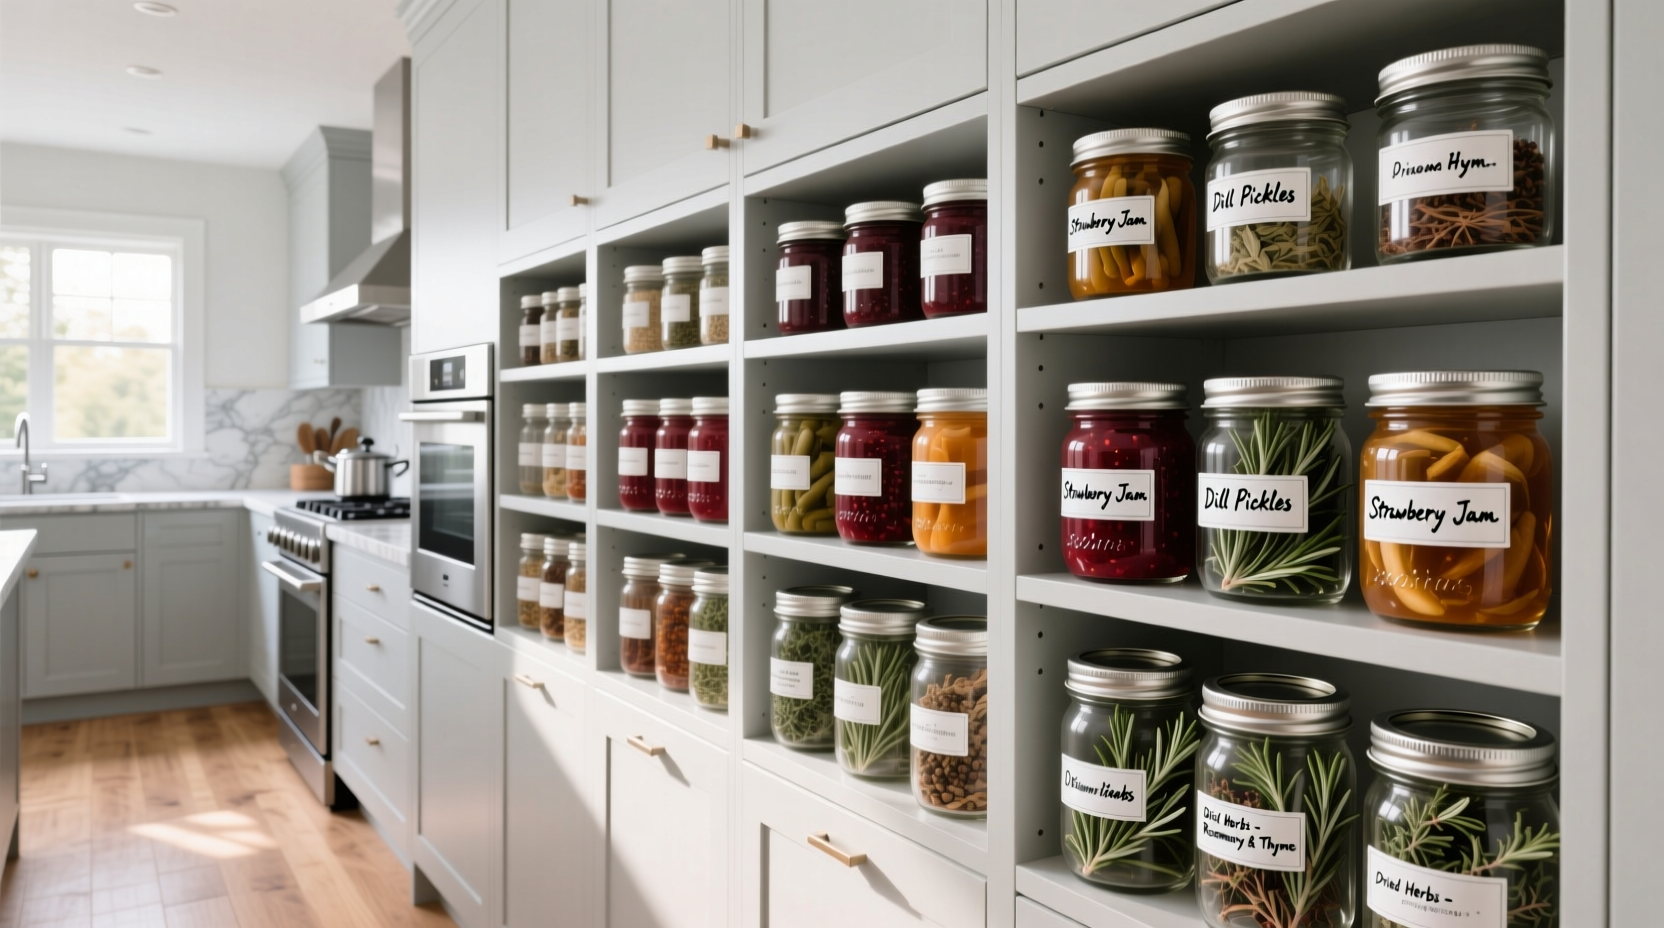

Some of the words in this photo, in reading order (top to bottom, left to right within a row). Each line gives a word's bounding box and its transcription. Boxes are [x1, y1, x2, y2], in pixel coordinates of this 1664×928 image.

[1213, 189, 1234, 212] Dill
[1241, 181, 1295, 207] Pickles
[1118, 209, 1147, 228] Jam
[1116, 483, 1147, 502] Jam
[1205, 488, 1229, 509] Dill
[1235, 488, 1292, 512] Pickles
[1453, 500, 1499, 525] Jam
[1259, 837, 1296, 857] Thyme
[1405, 881, 1439, 903] Herbs
